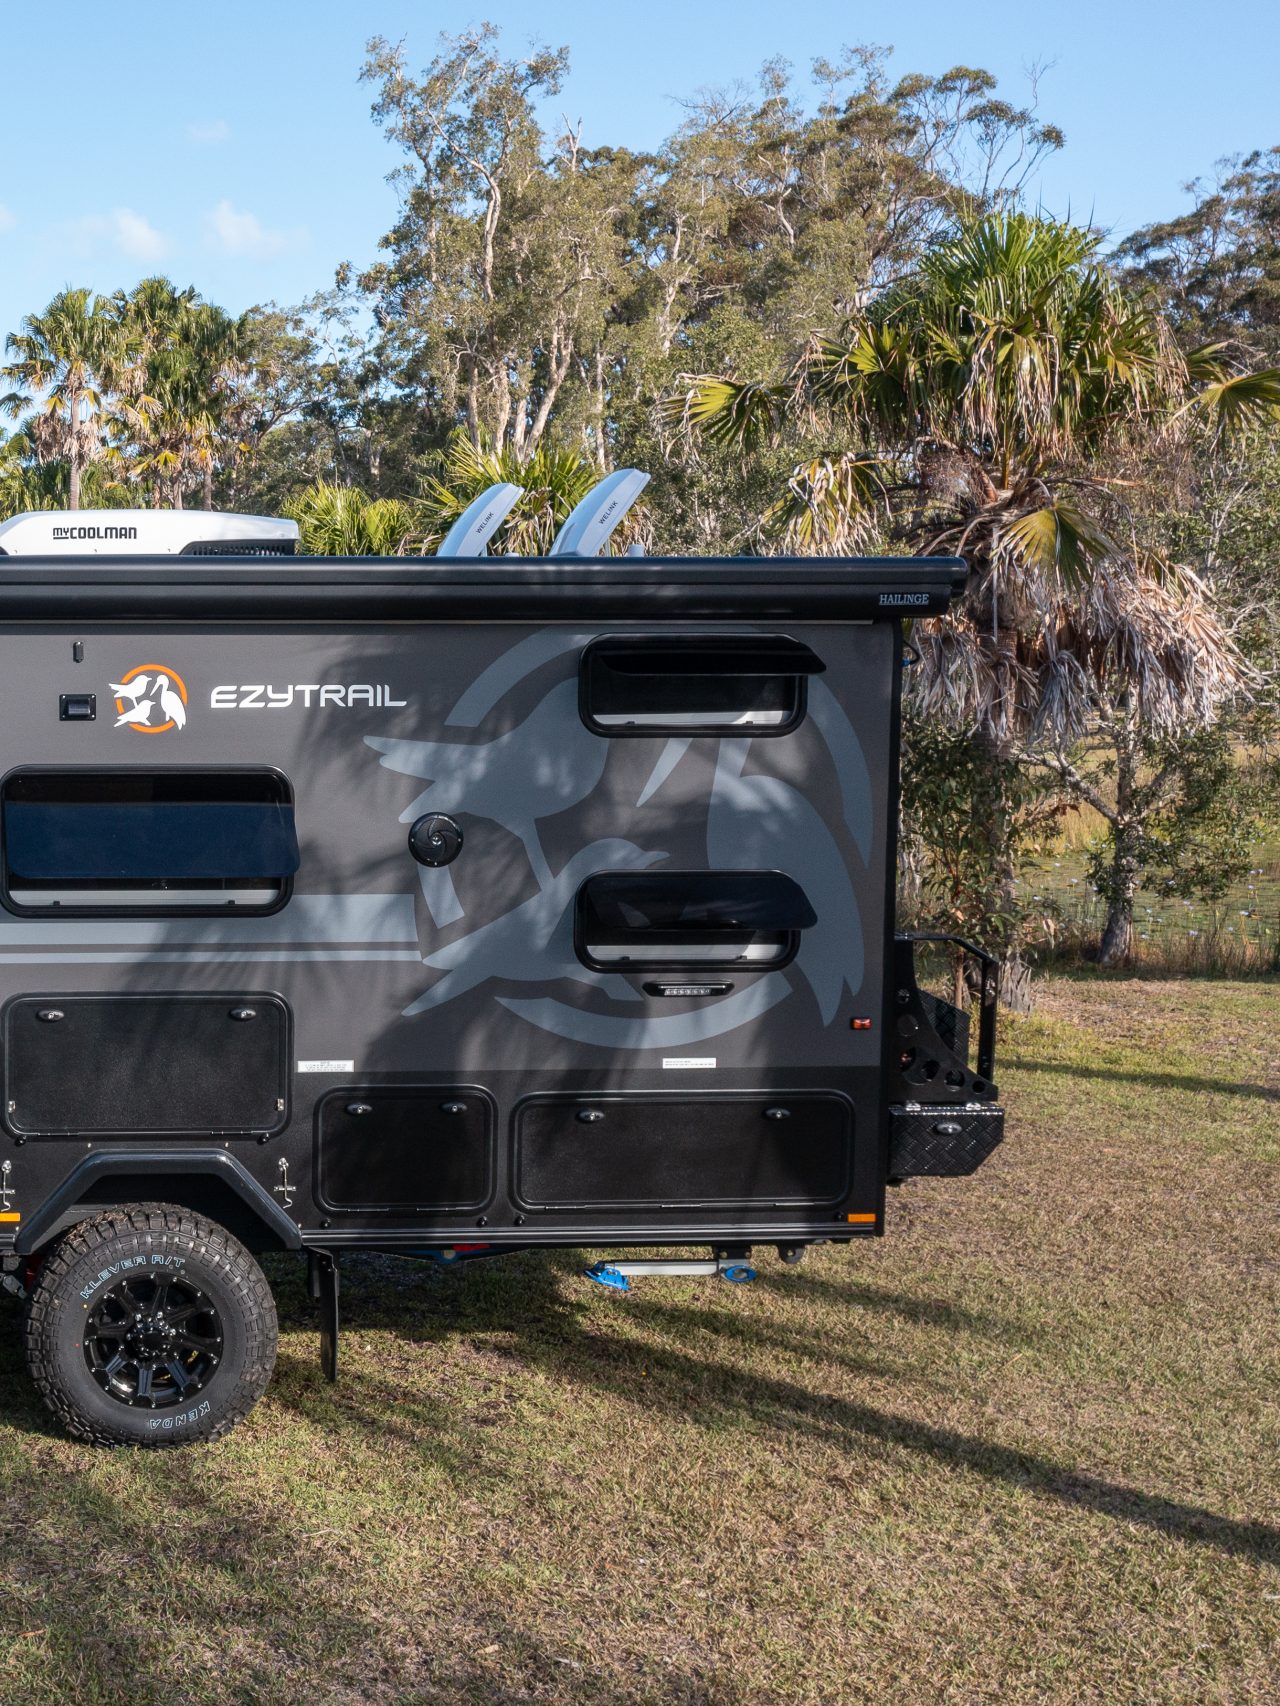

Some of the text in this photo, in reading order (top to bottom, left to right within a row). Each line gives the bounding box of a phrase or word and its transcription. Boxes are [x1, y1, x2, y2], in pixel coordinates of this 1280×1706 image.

[475, 511, 495, 534] WELINK
[598, 500, 619, 525] WELINK
[879, 593, 930, 605] HAILINGE
[210, 684, 408, 709] EZYTRAIL
[79, 1254, 186, 1300] KLEVER R/T
[149, 1400, 211, 1430] KENDA
